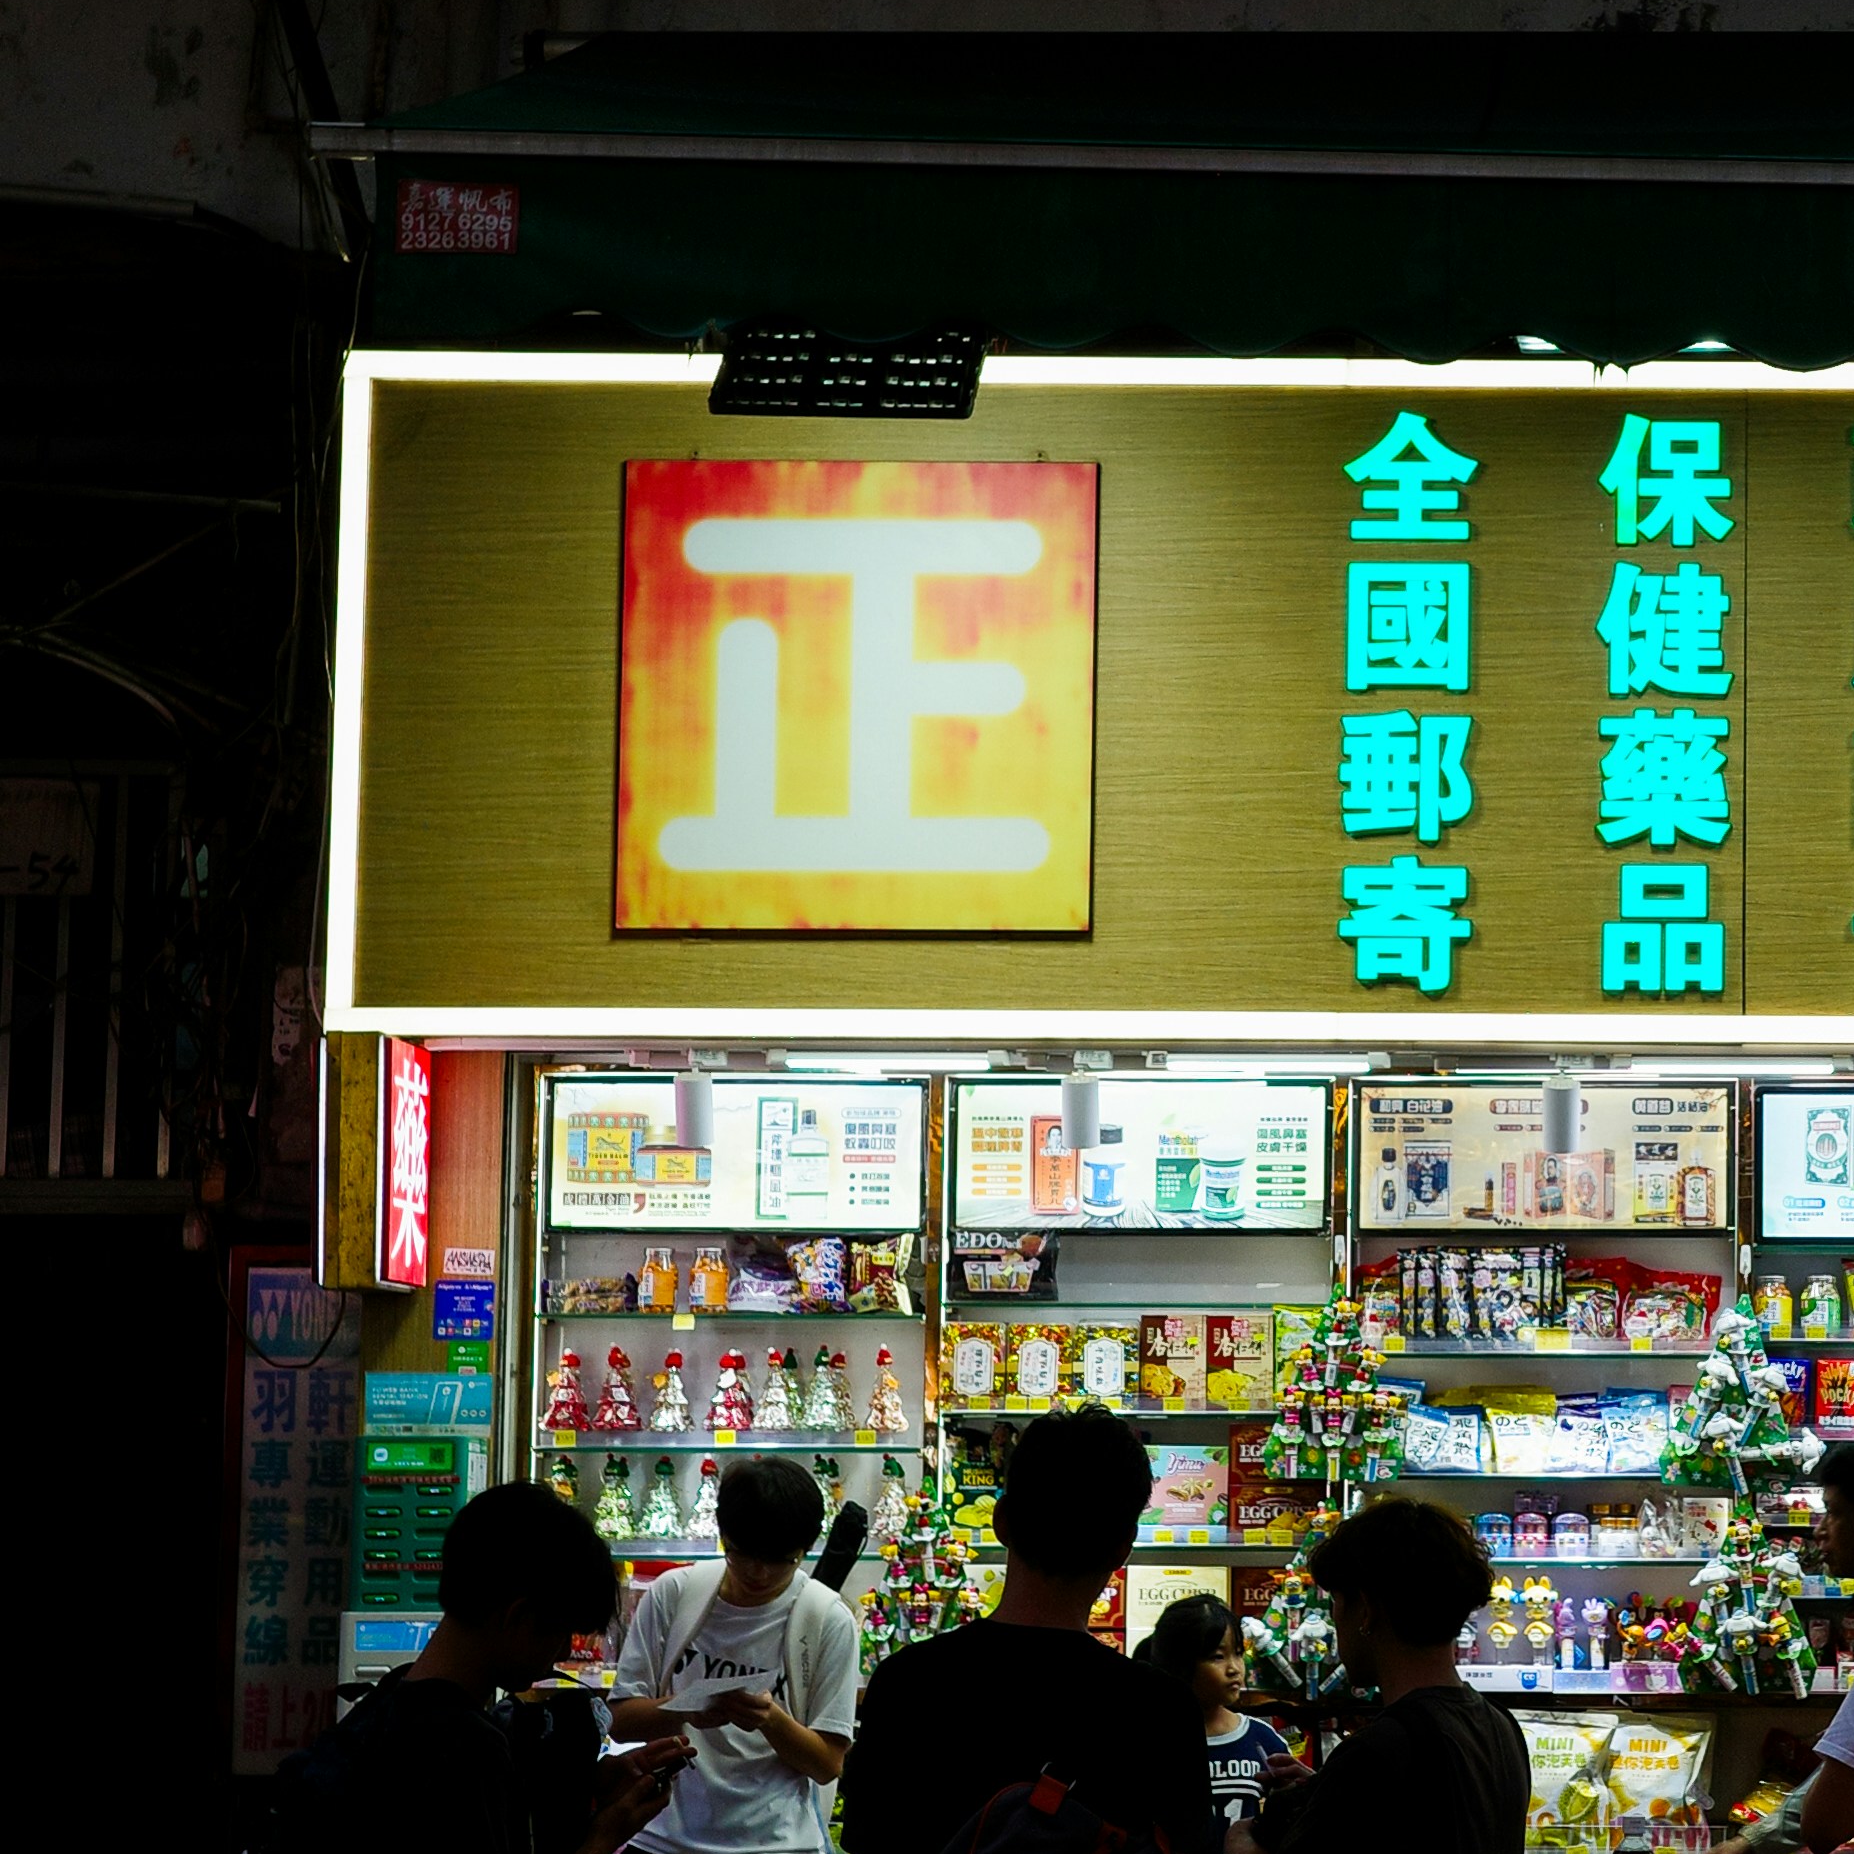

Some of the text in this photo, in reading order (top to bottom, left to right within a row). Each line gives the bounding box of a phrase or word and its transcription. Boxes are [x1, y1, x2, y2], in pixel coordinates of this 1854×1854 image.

[658, 518, 1051, 873] 正
[1338, 410, 1481, 997] 全國郵寄
[1596, 412, 1735, 996] 保健藥品
[390, 1058, 430, 1268] 藥
[956, 1233, 1003, 1249] EDO
[962, 1475, 995, 1486] KING
[1138, 1587, 1170, 1601] EGG
[1536, 1736, 1575, 1750] MINI
[1628, 1737, 1668, 1753] MINI
